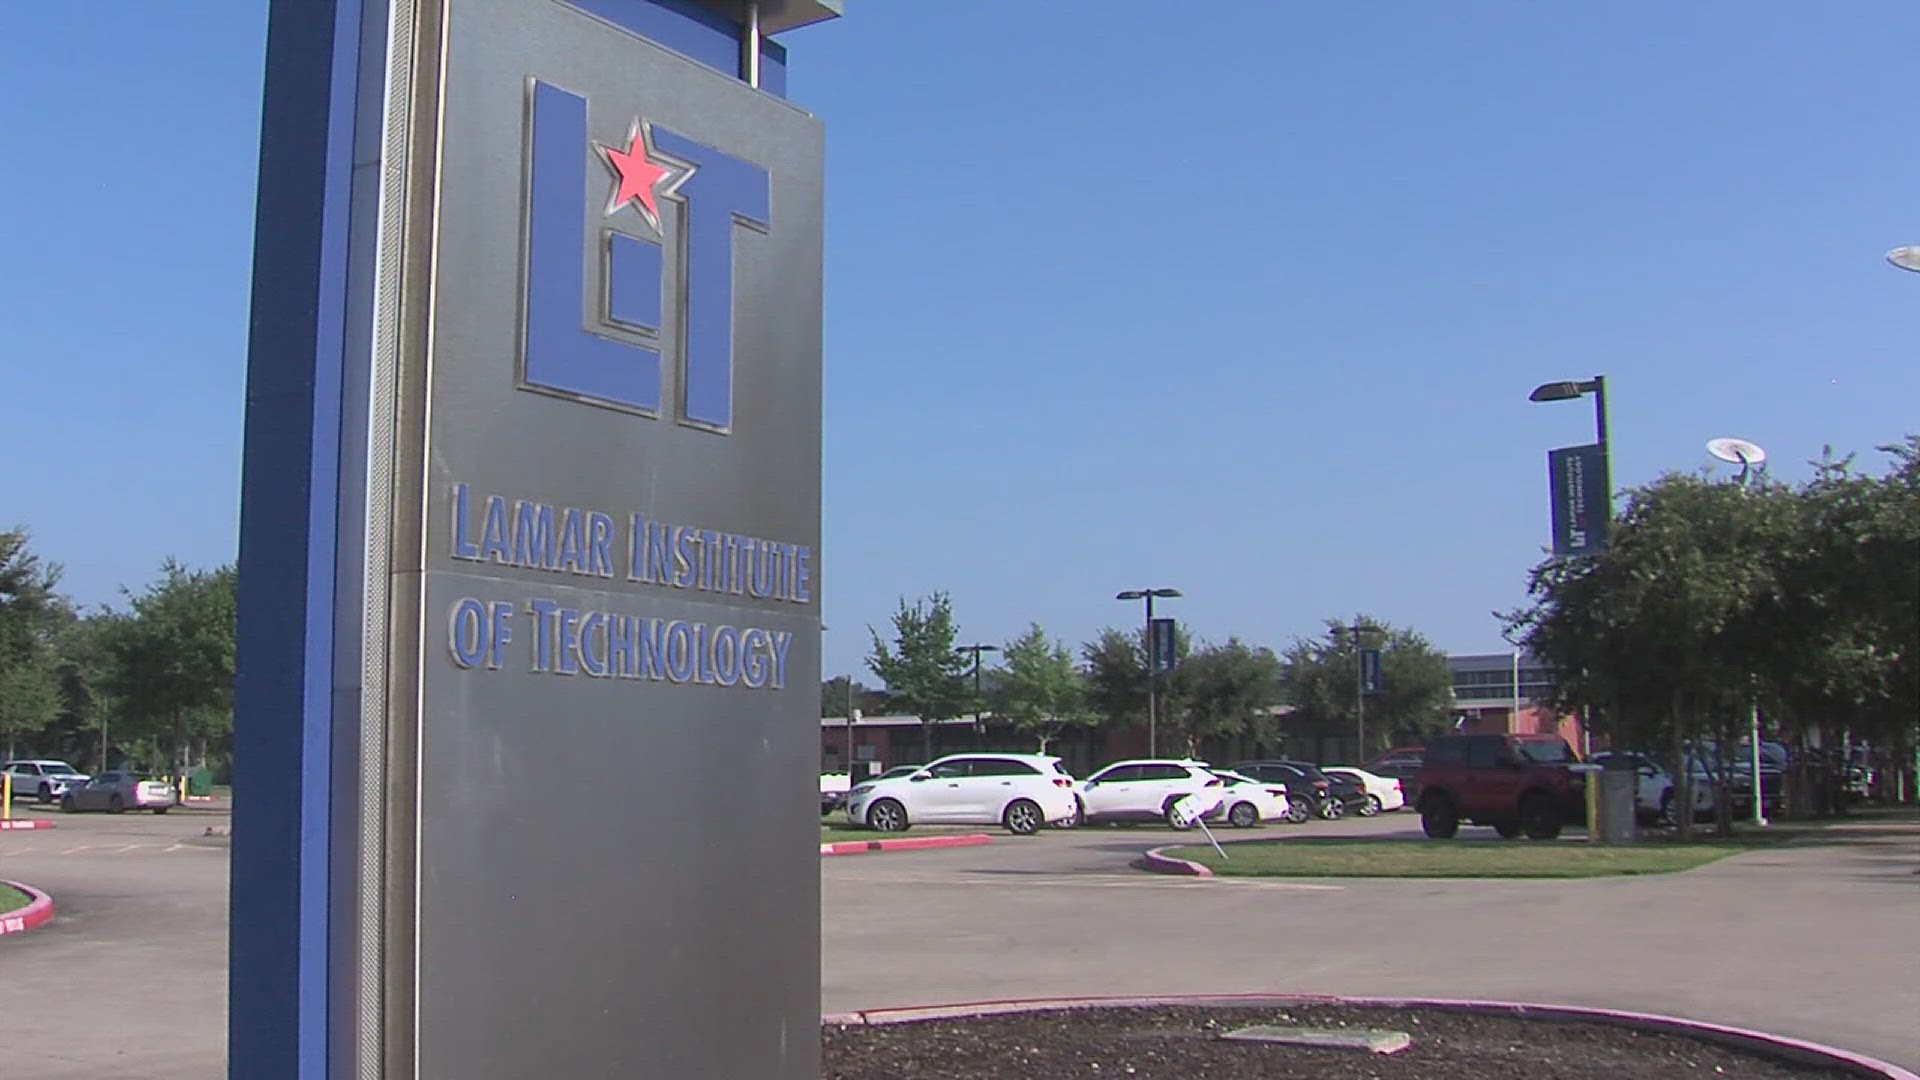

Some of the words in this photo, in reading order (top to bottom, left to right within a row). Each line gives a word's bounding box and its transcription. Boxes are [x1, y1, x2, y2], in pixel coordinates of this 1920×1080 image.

[450, 483, 614, 578] LAMAR
[627, 511, 810, 603] INSTITUTE
[449, 597, 513, 670] OF
[526, 598, 791, 689] TECHNOLOGY
